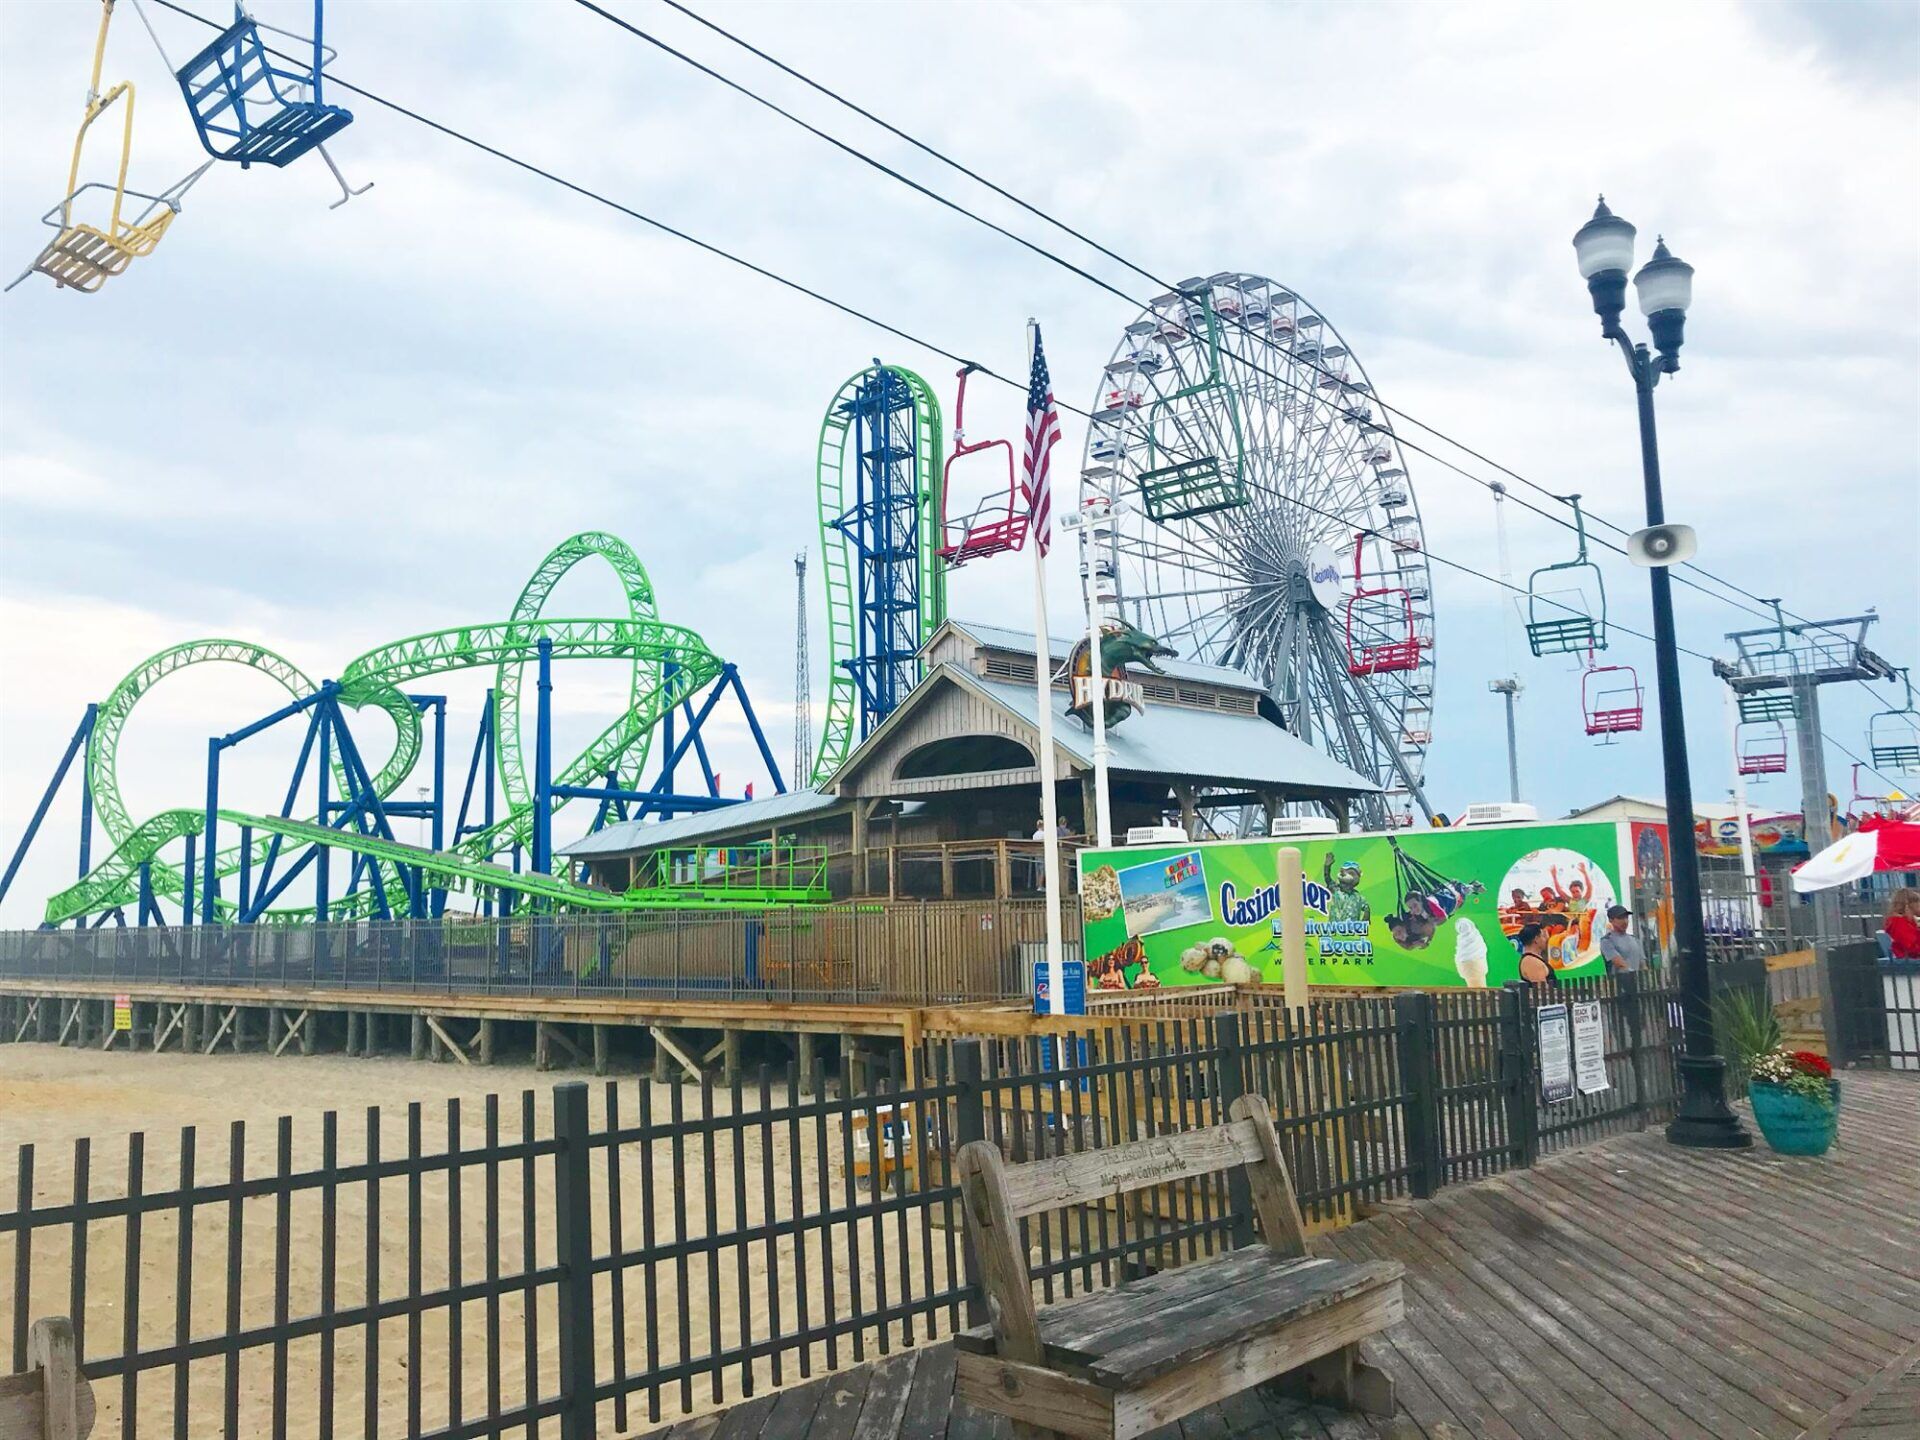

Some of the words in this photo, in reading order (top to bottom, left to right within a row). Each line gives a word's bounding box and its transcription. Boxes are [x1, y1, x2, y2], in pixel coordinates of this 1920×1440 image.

[1301, 872, 1331, 915] ier
[1319, 937, 1373, 957] Beach
[1274, 958, 1374, 966] WERPARK
